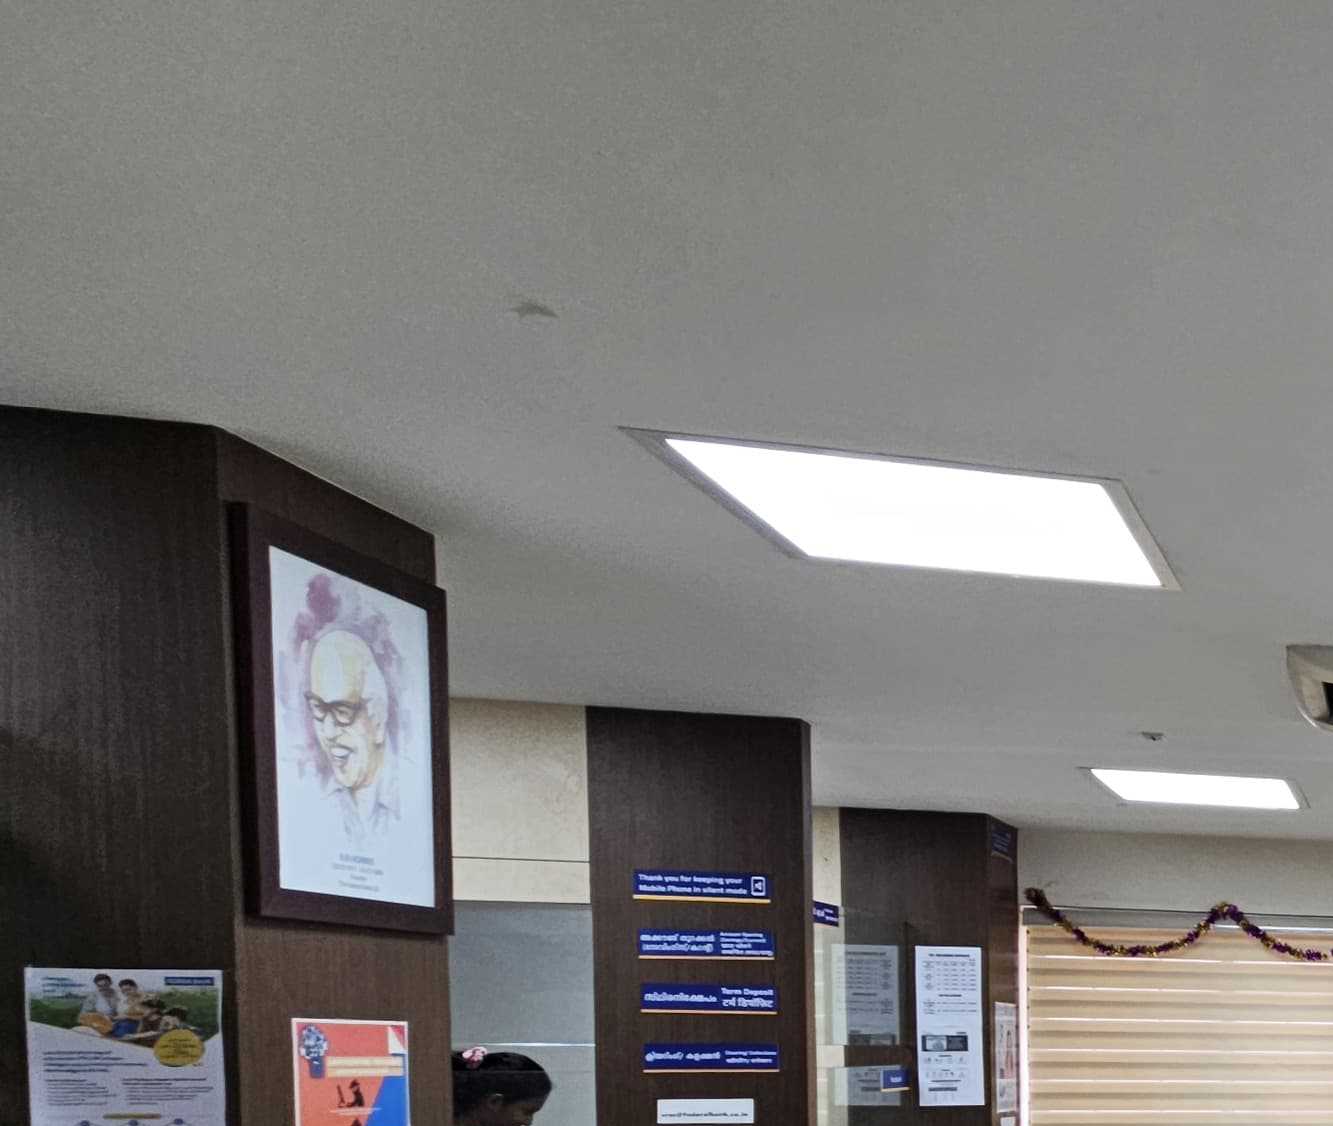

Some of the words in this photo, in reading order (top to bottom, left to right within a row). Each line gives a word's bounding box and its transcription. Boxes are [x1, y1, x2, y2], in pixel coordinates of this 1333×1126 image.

[638, 874, 663, 882] Thank
[725, 877, 742, 885] your
[721, 987, 742, 995] Term
[743, 988, 773, 996] Deposit
